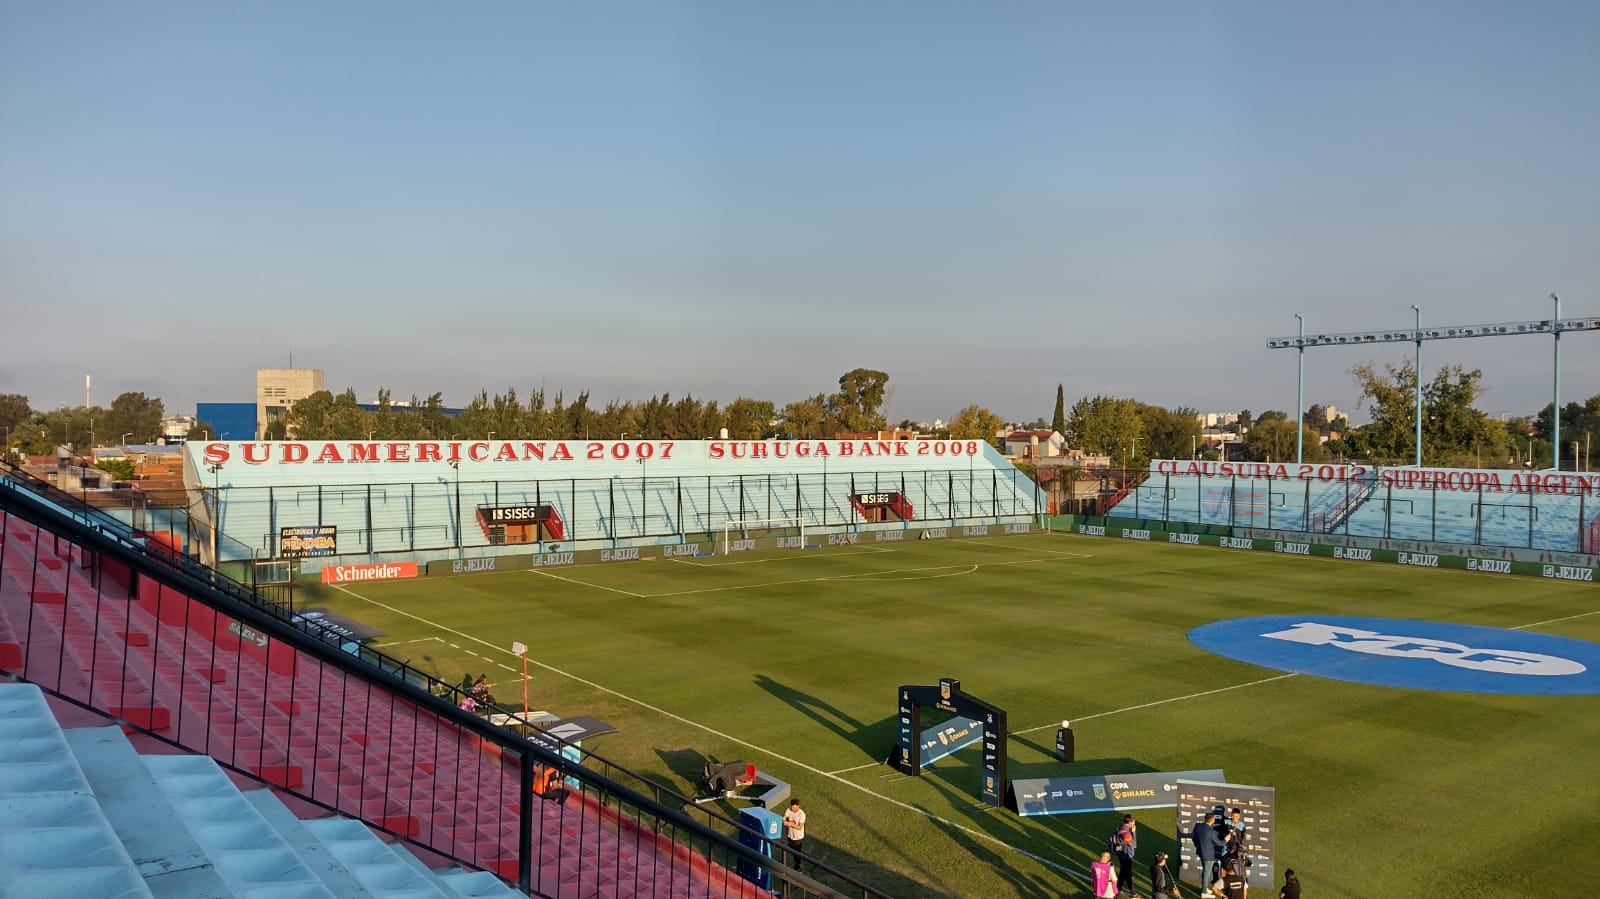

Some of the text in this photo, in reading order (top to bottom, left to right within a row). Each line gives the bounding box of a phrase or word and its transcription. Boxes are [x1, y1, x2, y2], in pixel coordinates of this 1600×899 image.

[204, 442, 674, 465] SUDAMERICANA 2007
[709, 441, 978, 459] SURUGA BANK 2008
[1157, 460, 1367, 484] CLAUSURA 2012
[1381, 469, 1504, 493] SUPERCOPA
[868, 494, 889, 504] SISEG
[504, 507, 535, 519] SISEG
[611, 547, 639, 560] JELUZ
[673, 543, 699, 556] JELUZ
[1343, 547, 1372, 561] JELUZ
[464, 557, 495, 572] JELUZ
[543, 551, 574, 565] JELUZ
[1408, 553, 1438, 567] JELUZ
[336, 565, 402, 581] Schneider
[1478, 559, 1511, 574] JELUZ
[1555, 565, 1593, 581] JELUZ
[1110, 782, 1129, 790] COPA
[1121, 789, 1156, 798] BINANCE
